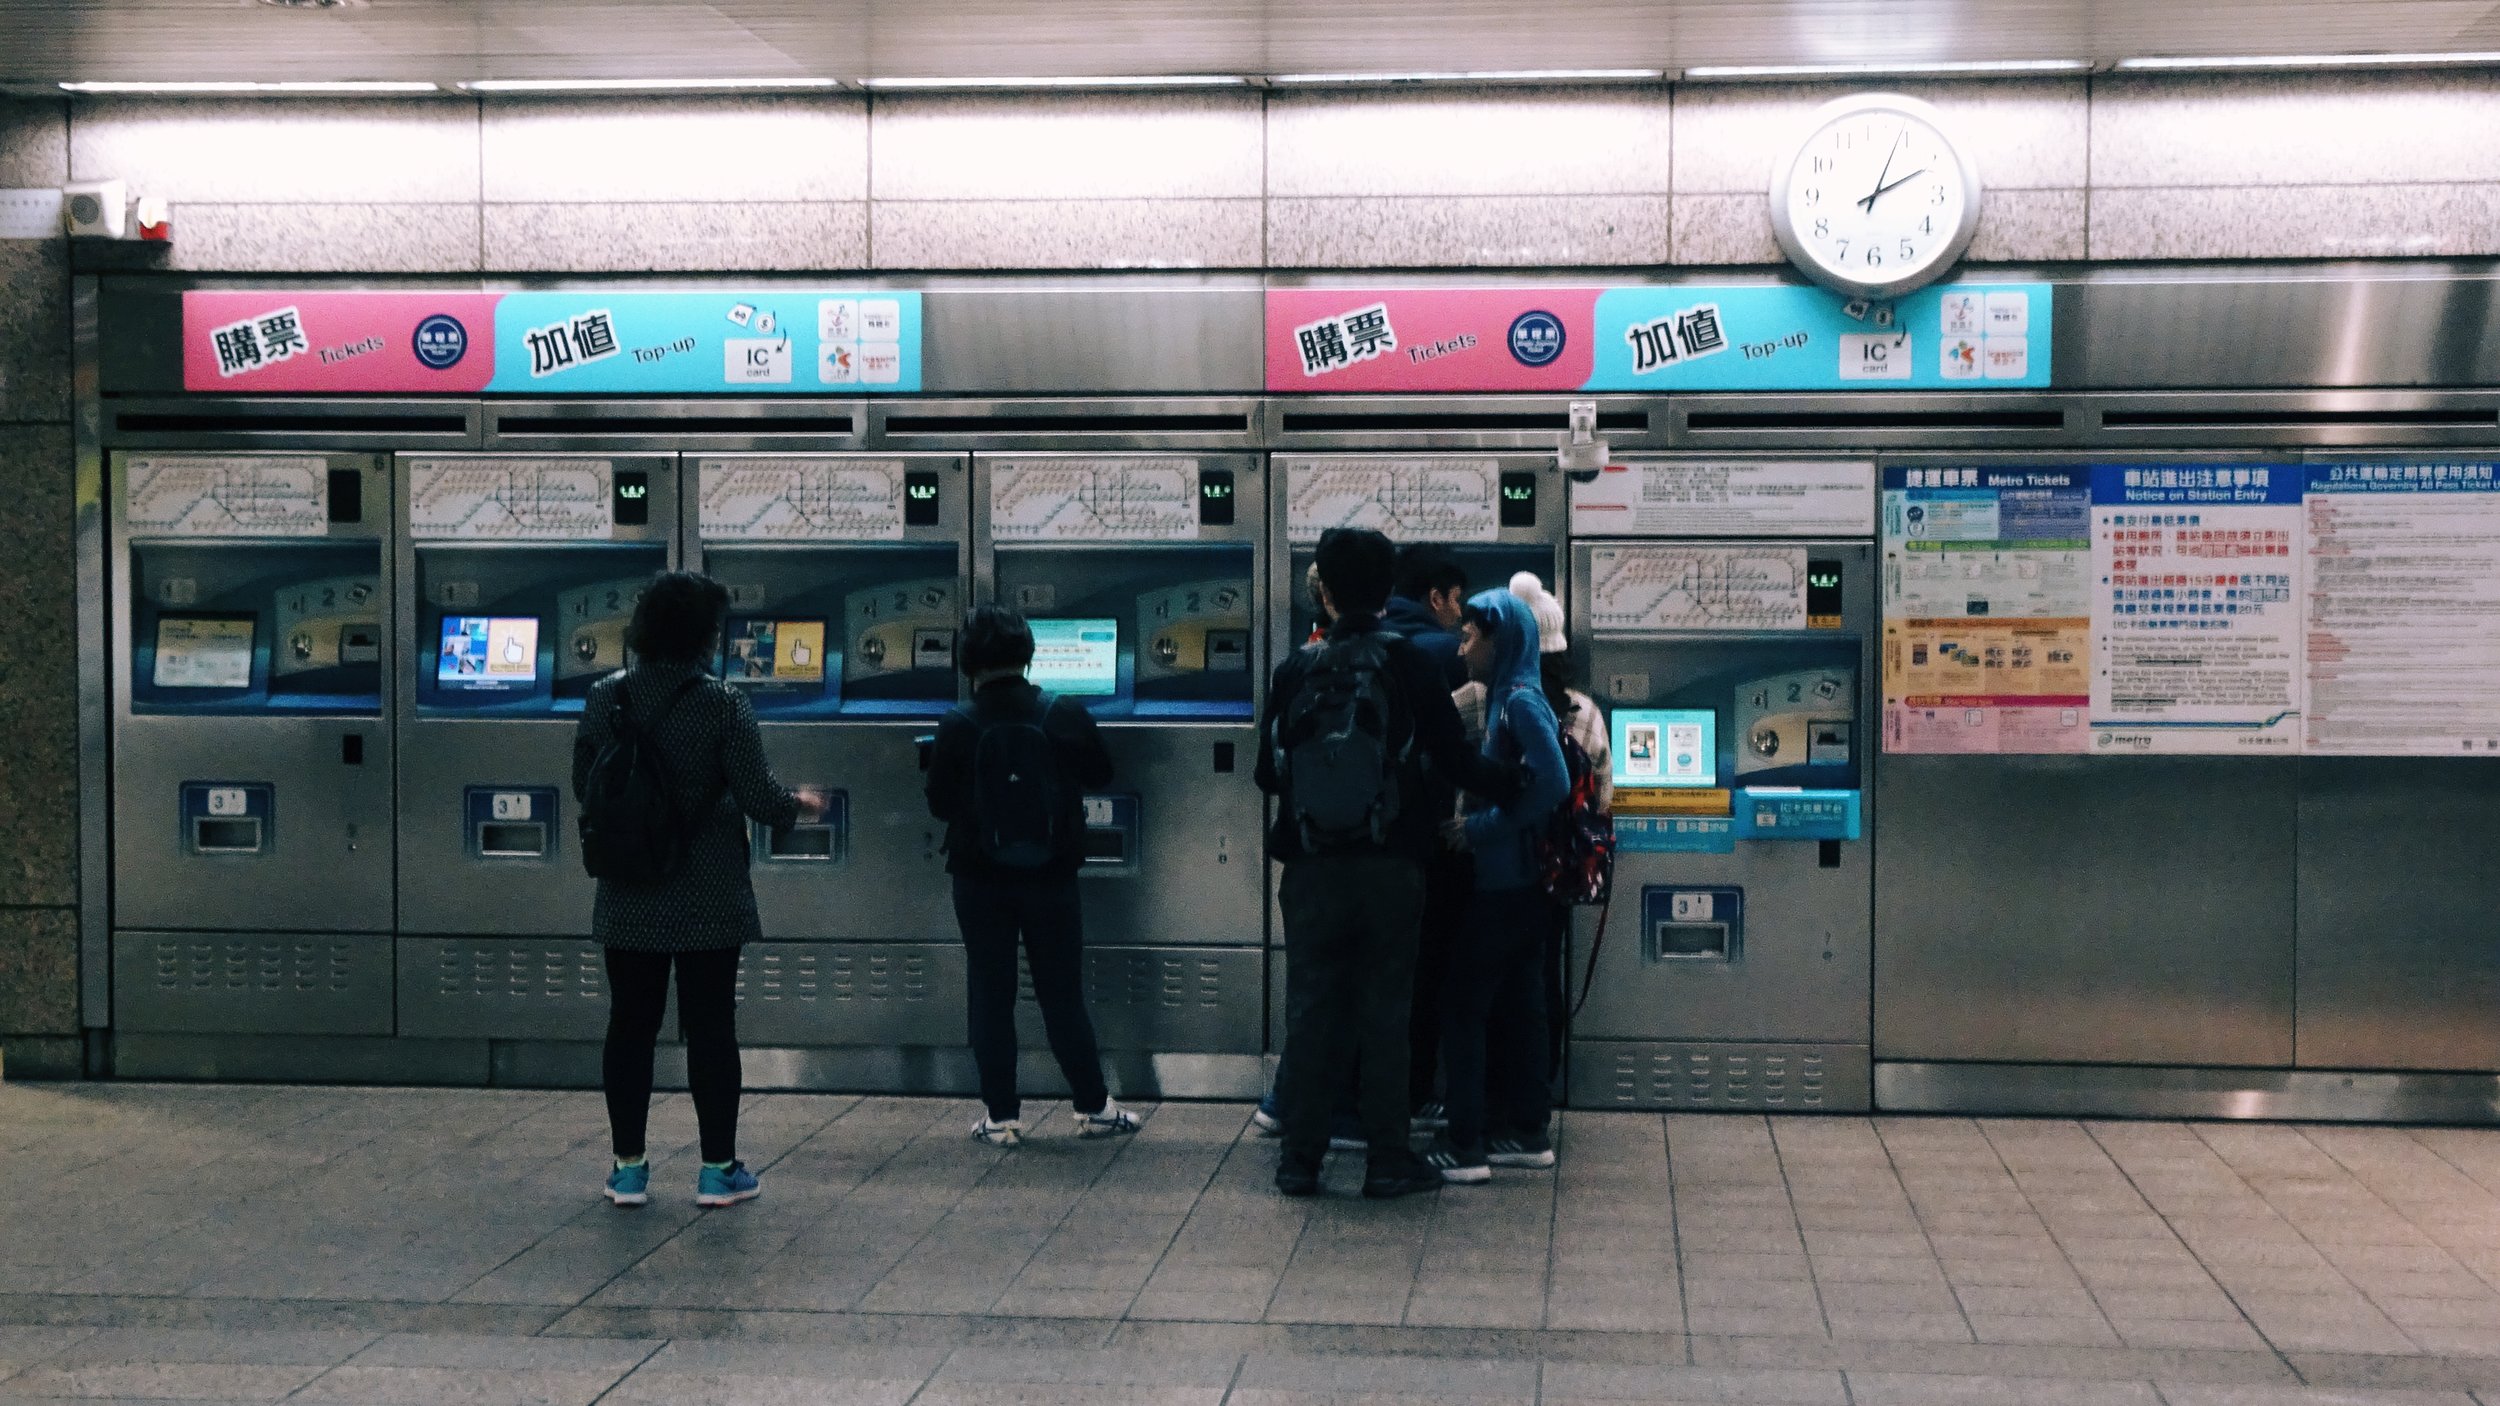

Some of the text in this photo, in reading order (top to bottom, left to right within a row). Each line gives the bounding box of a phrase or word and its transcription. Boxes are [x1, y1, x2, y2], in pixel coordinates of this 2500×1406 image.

[1836, 131, 1851, 149] 11
[1813, 155, 1833, 174] 10
[1805, 186, 1820, 207] 9
[1930, 184, 1945, 206] 3
[1814, 216, 1829, 239] 8
[1918, 214, 1934, 236] 4
[1836, 239, 1850, 262] 7
[1866, 245, 1882, 268] 6
[1899, 238, 1914, 261] 5
[214, 311, 304, 373] 購票
[527, 314, 617, 373] 加值
[1298, 308, 1394, 371] 購票
[1406, 332, 1477, 365] Tickets
[1629, 308, 1725, 370] 加值
[1739, 331, 1809, 361] Top-up
[318, 336, 385, 366] Tickets
[631, 336, 696, 364] Top-up
[746, 348, 769, 366] IC
[1863, 343, 1887, 362] IC
[746, 367, 770, 377] card
[1862, 363, 1888, 373] card
[1988, 474, 2071, 487] Metro Tickets
[2125, 489, 2268, 503] Notice on Station Entry
[606, 590, 619, 610] 2
[1615, 679, 1623, 694] 1
[1787, 682, 1801, 703] 2
[2115, 734, 2152, 745] metro
[213, 795, 224, 810] 3
[498, 800, 509, 814] 3
[1678, 899, 1688, 914] 3
